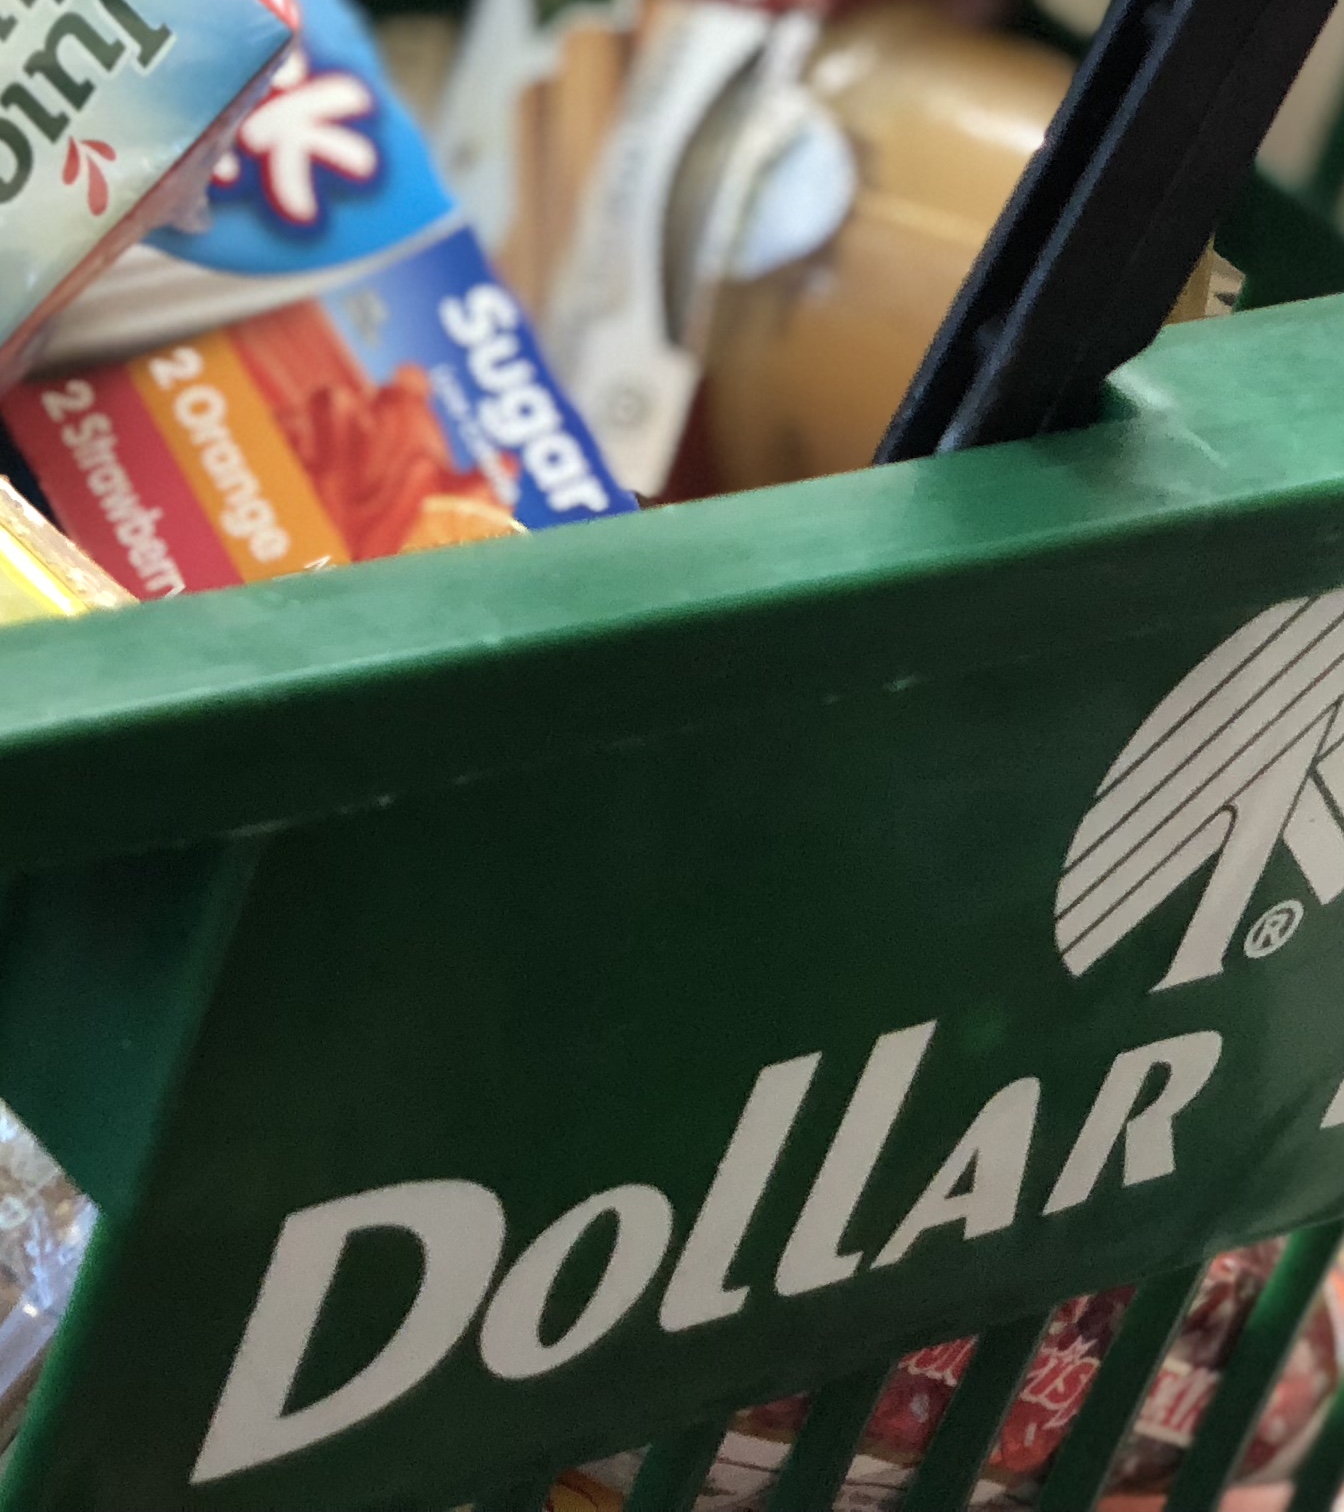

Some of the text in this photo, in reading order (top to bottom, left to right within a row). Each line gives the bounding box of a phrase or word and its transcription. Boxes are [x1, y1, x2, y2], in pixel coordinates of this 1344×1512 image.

[39, 375, 97, 423] 2
[146, 341, 291, 563] 2 Orange
[438, 283, 609, 512] Sugar
[191, 1022, 1222, 1484] DOLLAR
